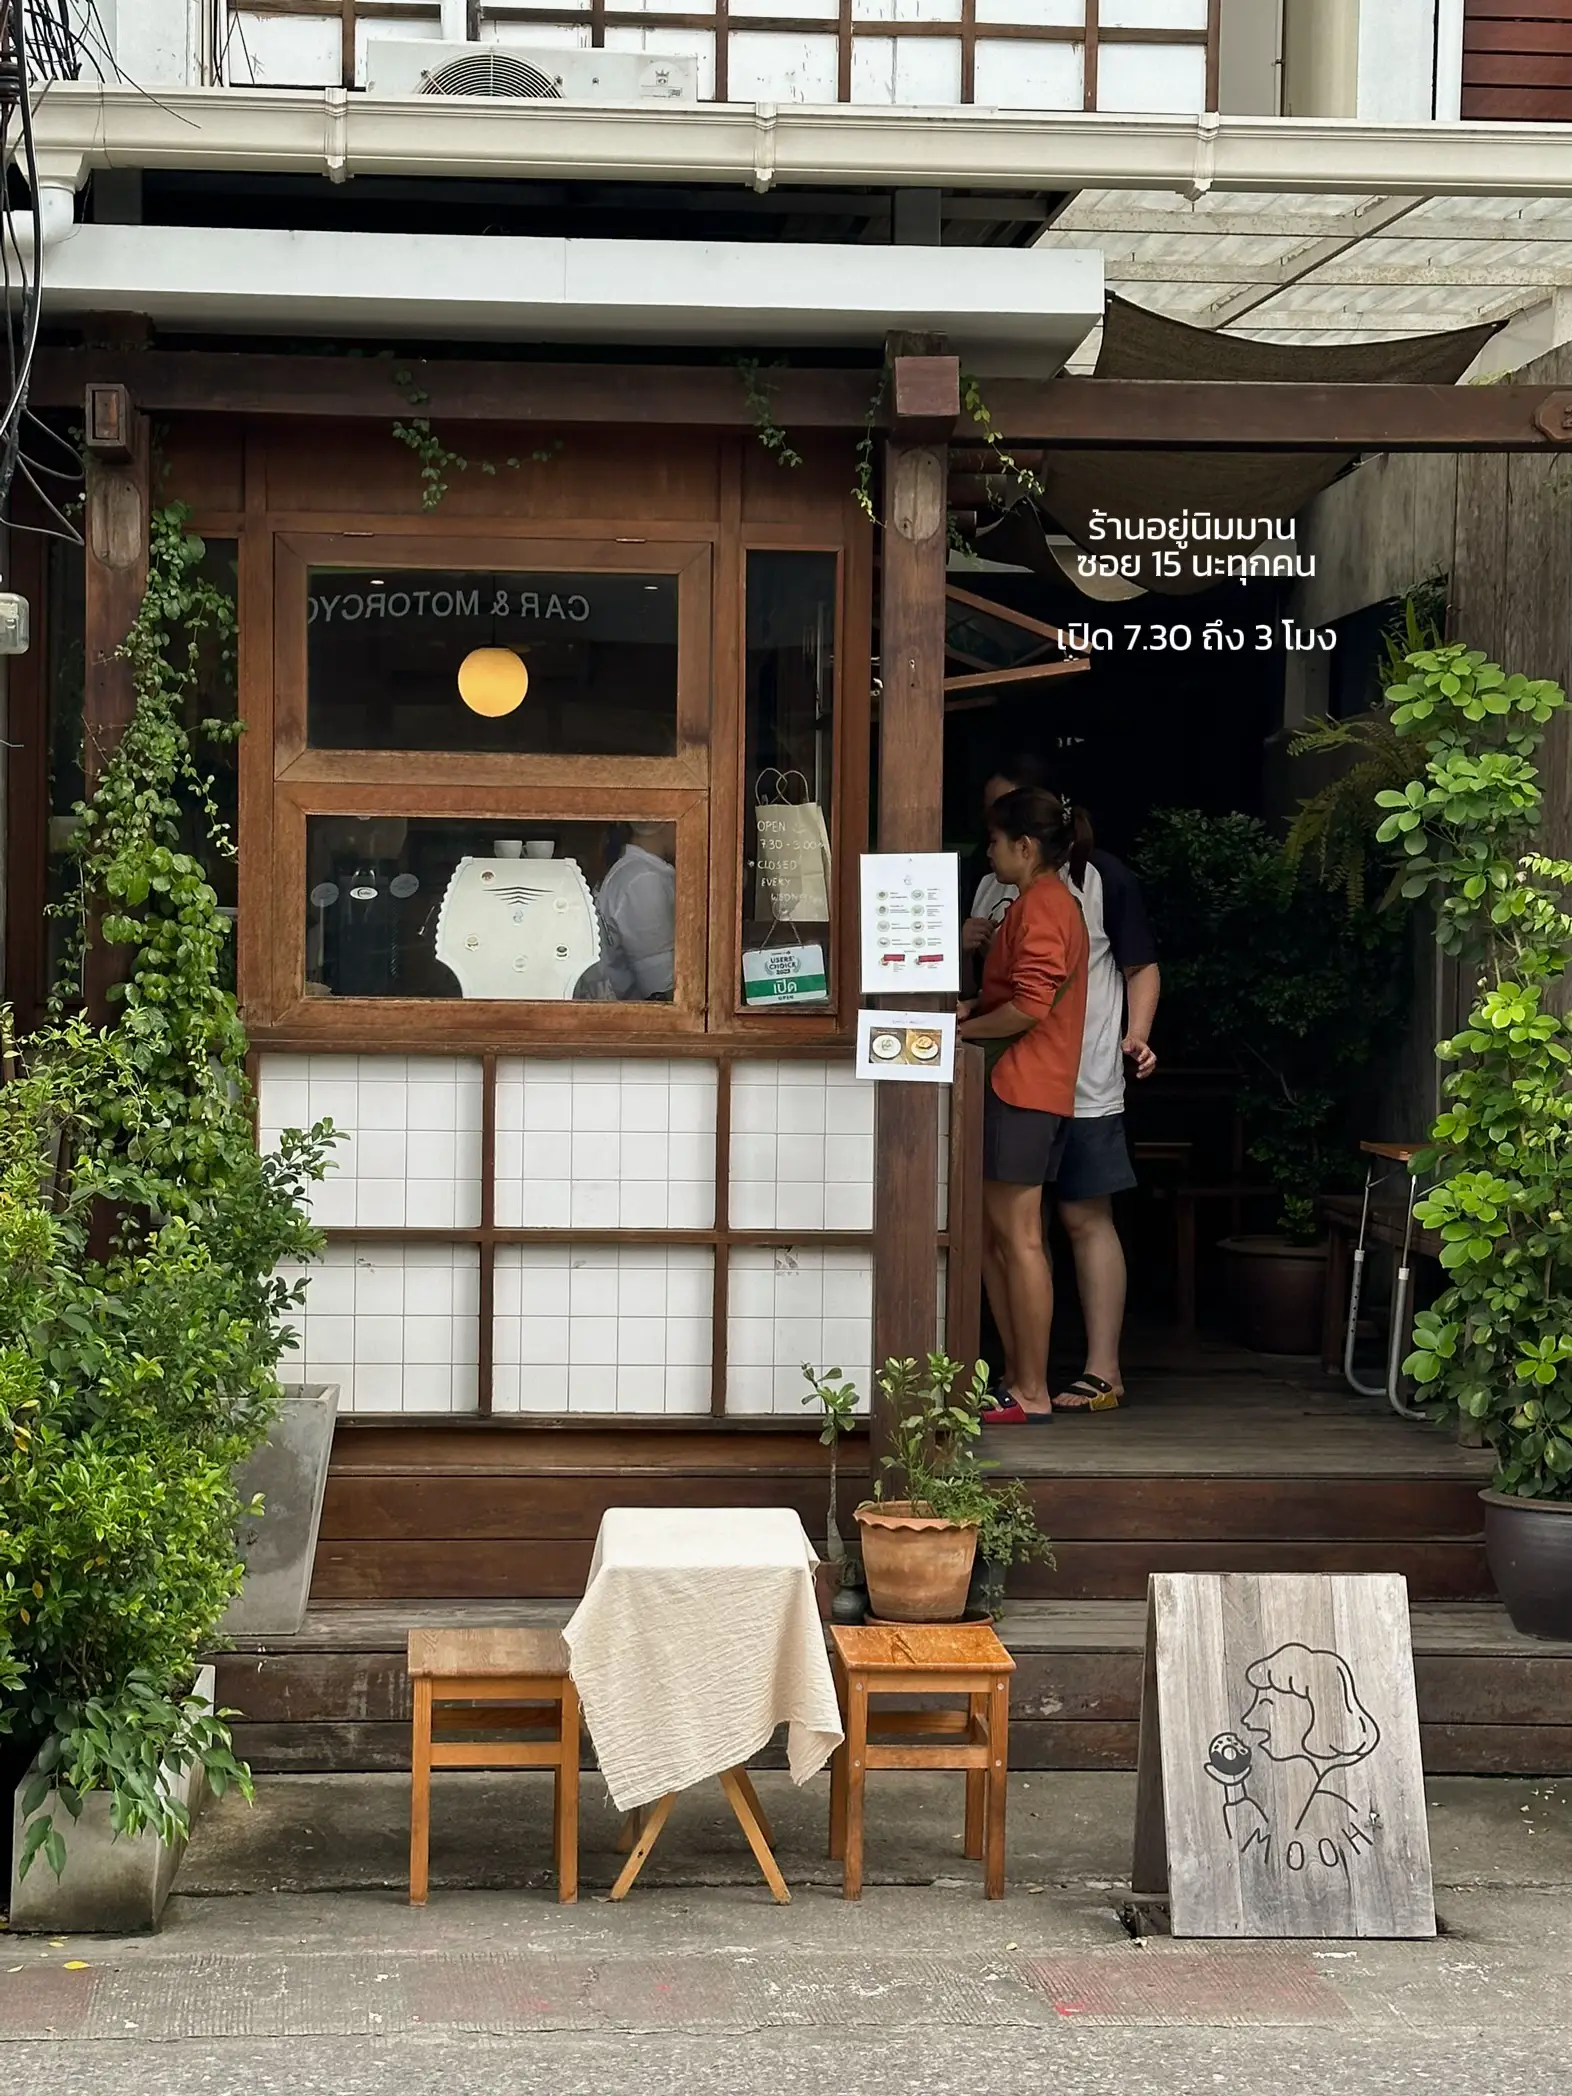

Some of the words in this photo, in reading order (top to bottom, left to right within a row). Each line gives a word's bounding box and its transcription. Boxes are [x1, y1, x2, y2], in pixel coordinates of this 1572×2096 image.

[757, 820, 786, 833] OPEN
[757, 860, 797, 870] CLOSED
[761, 877, 790, 888] EVERY
[773, 979, 797, 994] เปิด
[1241, 1822, 1373, 1871] MOOH
